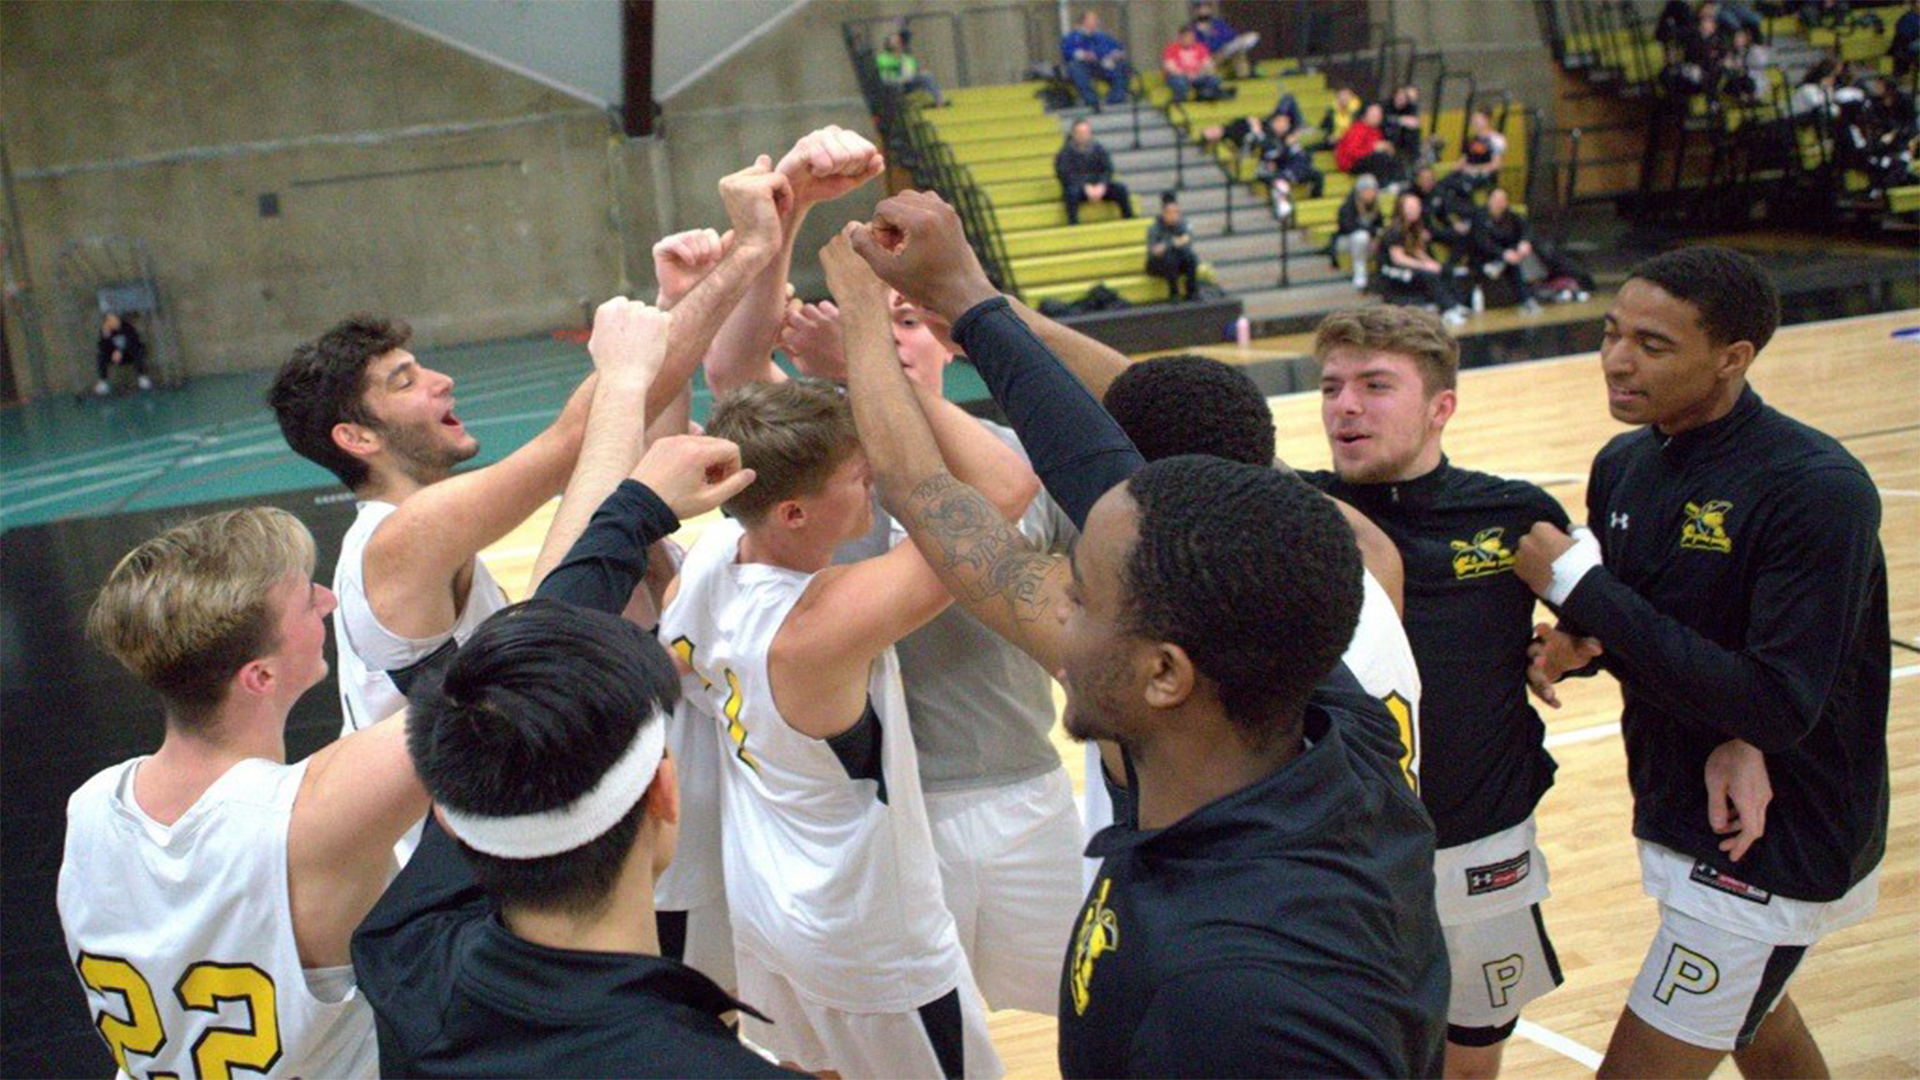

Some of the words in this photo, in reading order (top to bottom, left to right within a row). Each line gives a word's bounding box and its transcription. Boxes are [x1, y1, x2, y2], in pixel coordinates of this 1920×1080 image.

[1482, 953, 1525, 1008] P
[1652, 942, 1721, 1006] P
[76, 950, 283, 1080] 22
